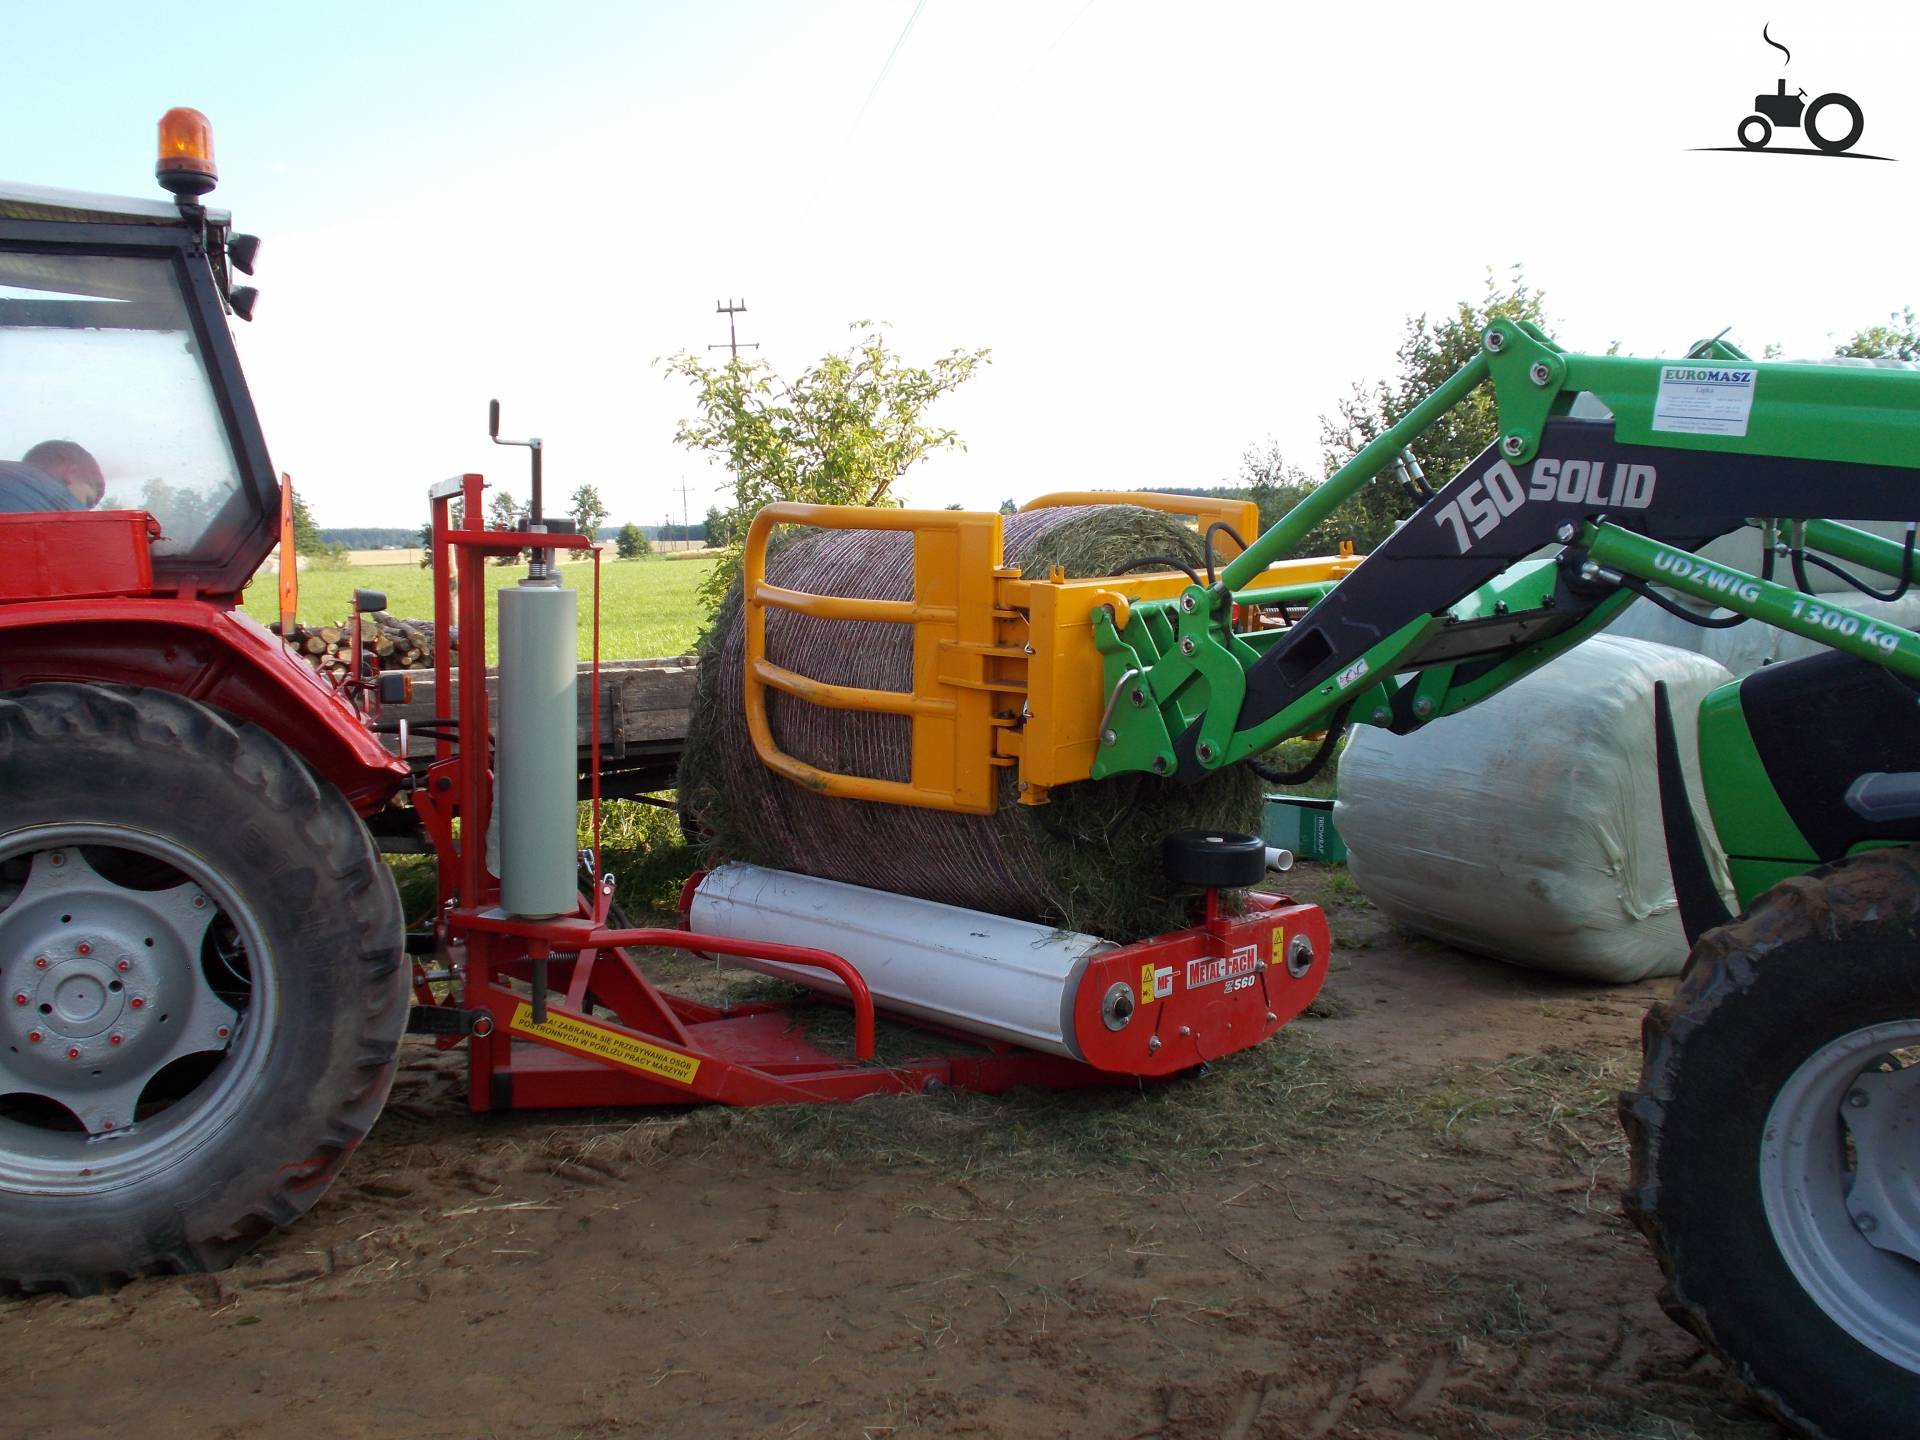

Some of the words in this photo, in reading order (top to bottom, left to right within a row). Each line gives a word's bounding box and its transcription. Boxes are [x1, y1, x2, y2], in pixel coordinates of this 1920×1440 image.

[1664, 369, 1751, 383] EUROMASZ
[1434, 458, 1526, 555] 750
[1529, 458, 1657, 509] SOLID
[1654, 550, 1762, 604] UDZWIG
[1790, 598, 1860, 637] 1300
[1861, 623, 1901, 656] kg
[518, 1018, 579, 1043] POSTRONNYCH
[580, 1037, 589, 1046] W
[623, 1052, 652, 1066] PRACY
[652, 1061, 689, 1078] MASZYNY
[557, 1021, 598, 1040] ZABRANIA
[613, 1039, 668, 1062] PRZEBYWANIA
